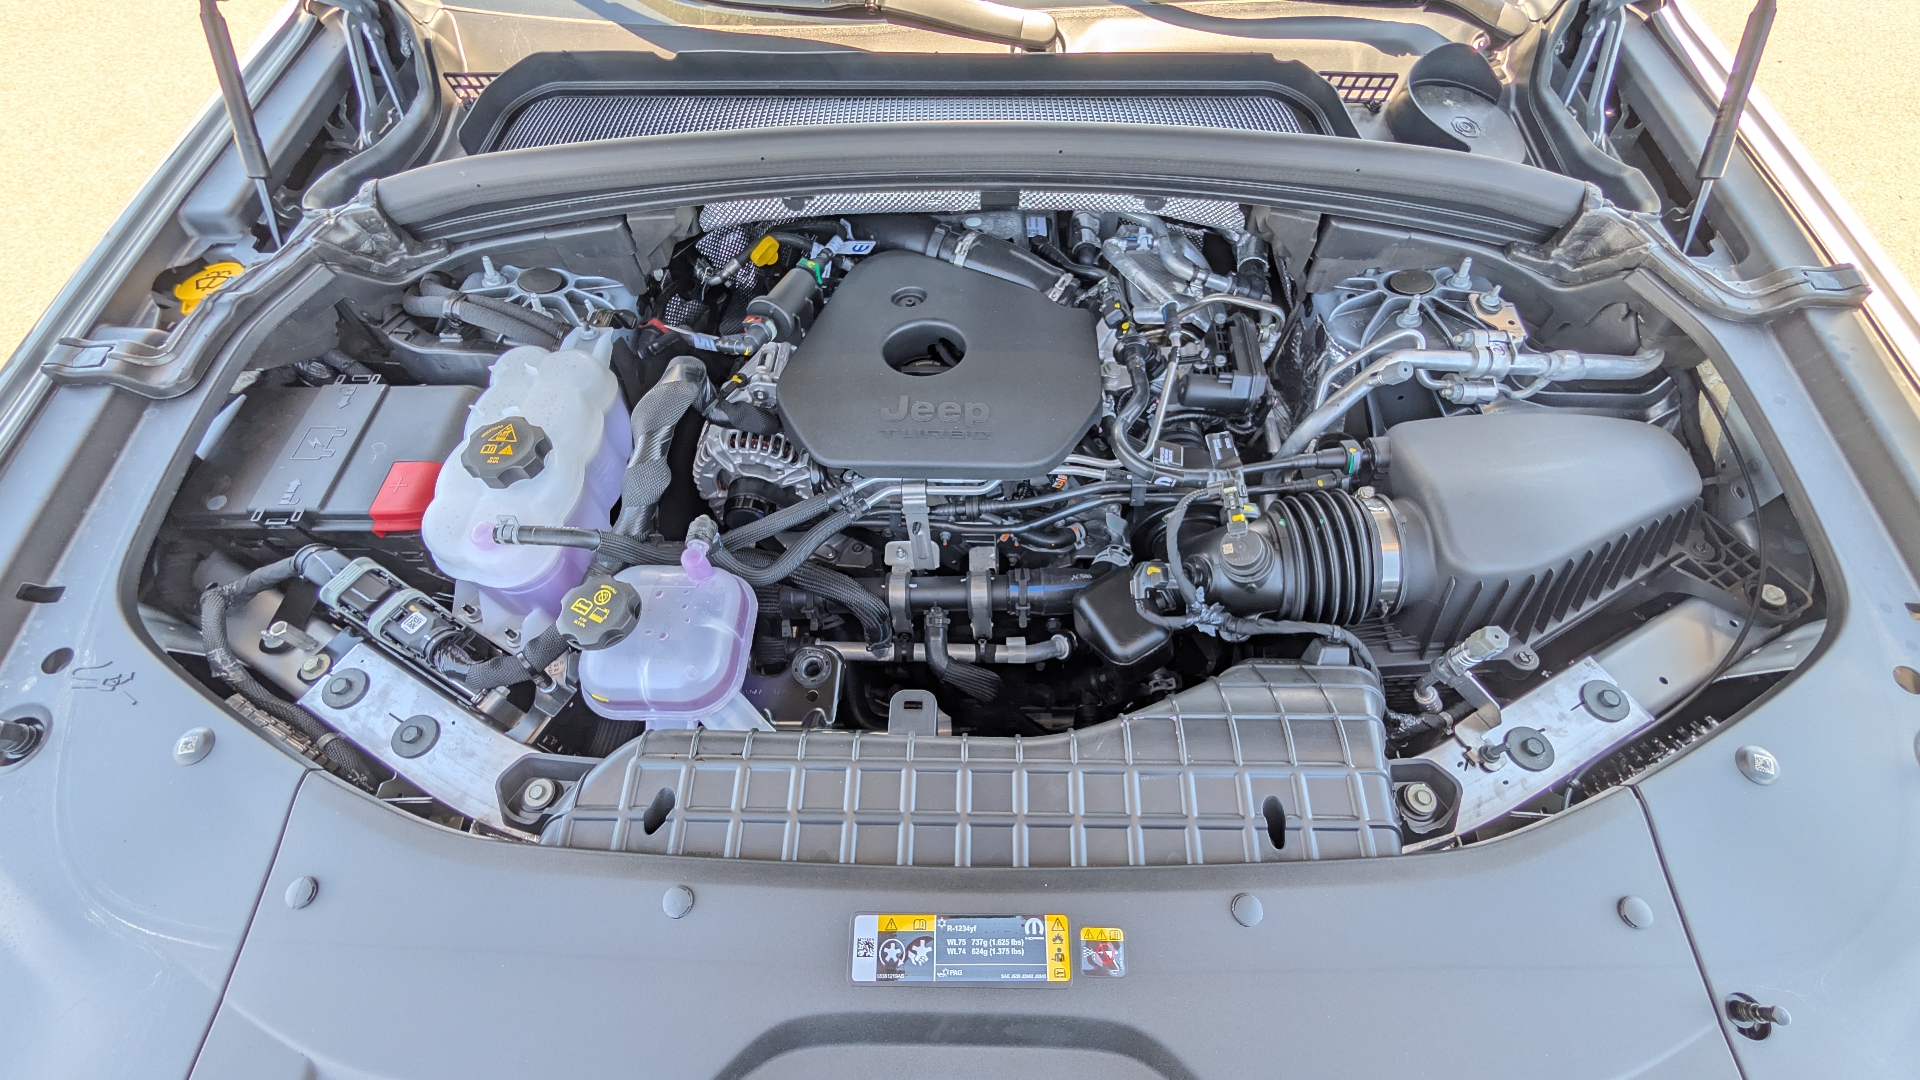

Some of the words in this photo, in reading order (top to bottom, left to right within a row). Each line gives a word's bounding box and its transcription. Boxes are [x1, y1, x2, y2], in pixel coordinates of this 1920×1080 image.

[880, 395, 990, 428] Jeep
[878, 429, 991, 440] TURBO
[946, 925, 977, 934] R-1234yf
[971, 939, 988, 947] 737g
[989, 939, 1010, 947] (1.625
[1011, 939, 1025, 947] lbs)
[971, 948, 988, 957] 624g
[989, 948, 1010, 957] (1.375
[1011, 948, 1025, 957] lbs)
